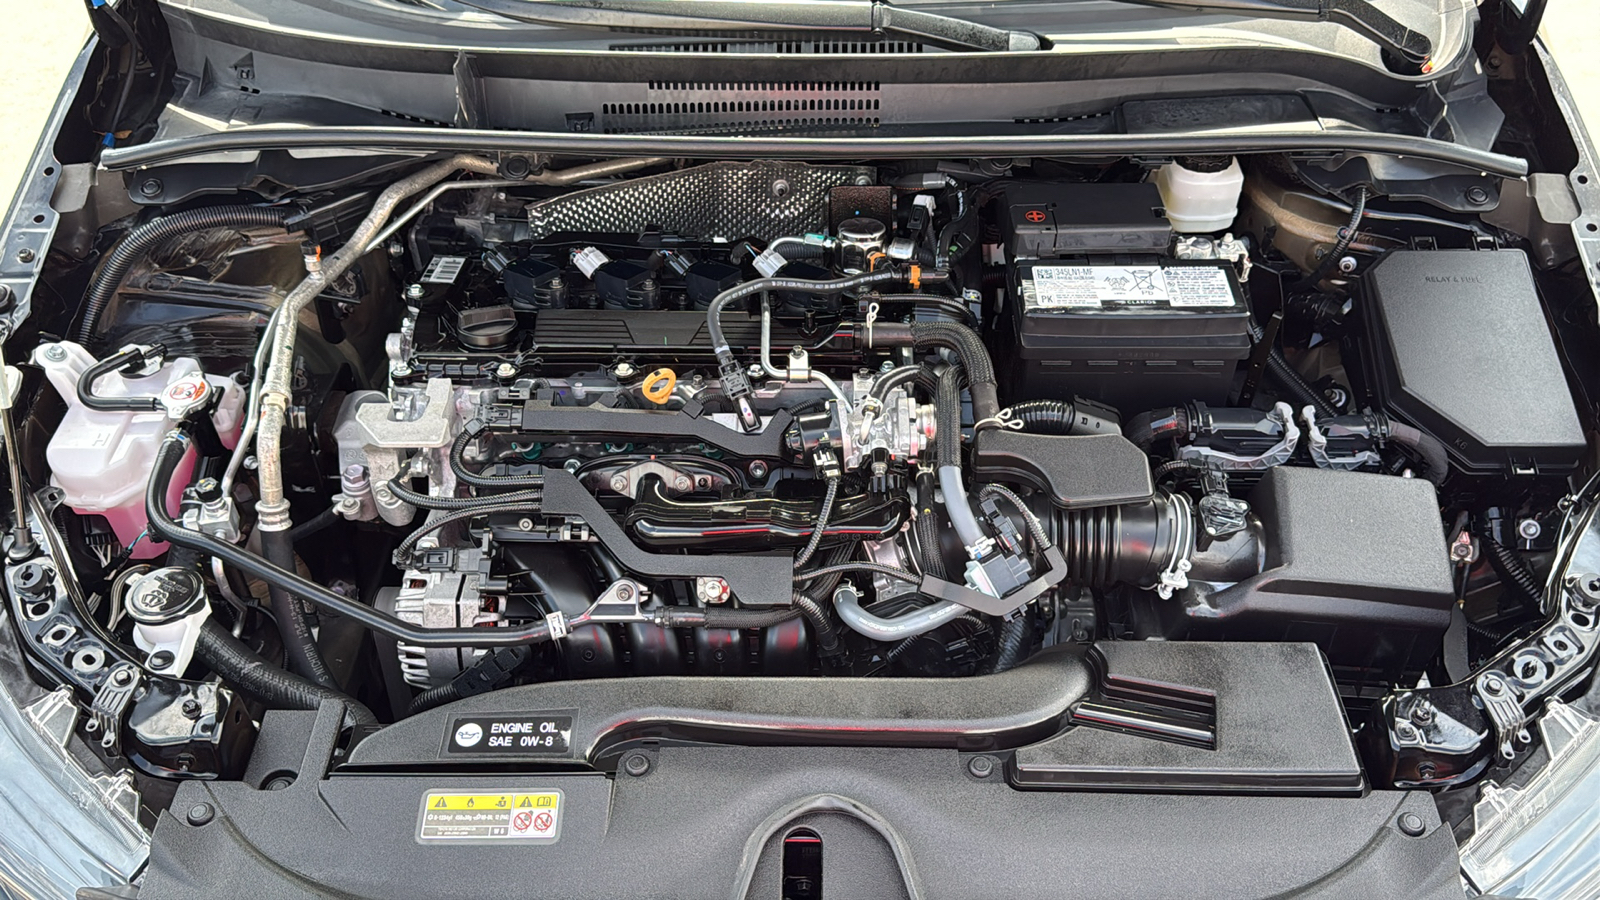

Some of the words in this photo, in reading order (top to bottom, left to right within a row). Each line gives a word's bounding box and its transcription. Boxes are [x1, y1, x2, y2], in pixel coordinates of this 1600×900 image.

[1055, 268, 1093, 276] 345LN1-MF
[1041, 295, 1053, 303] PK
[490, 722, 533, 734] ENGINE
[539, 722, 558, 733] OIL
[488, 736, 513, 747] SAE
[520, 735, 553, 747] 0W-8
